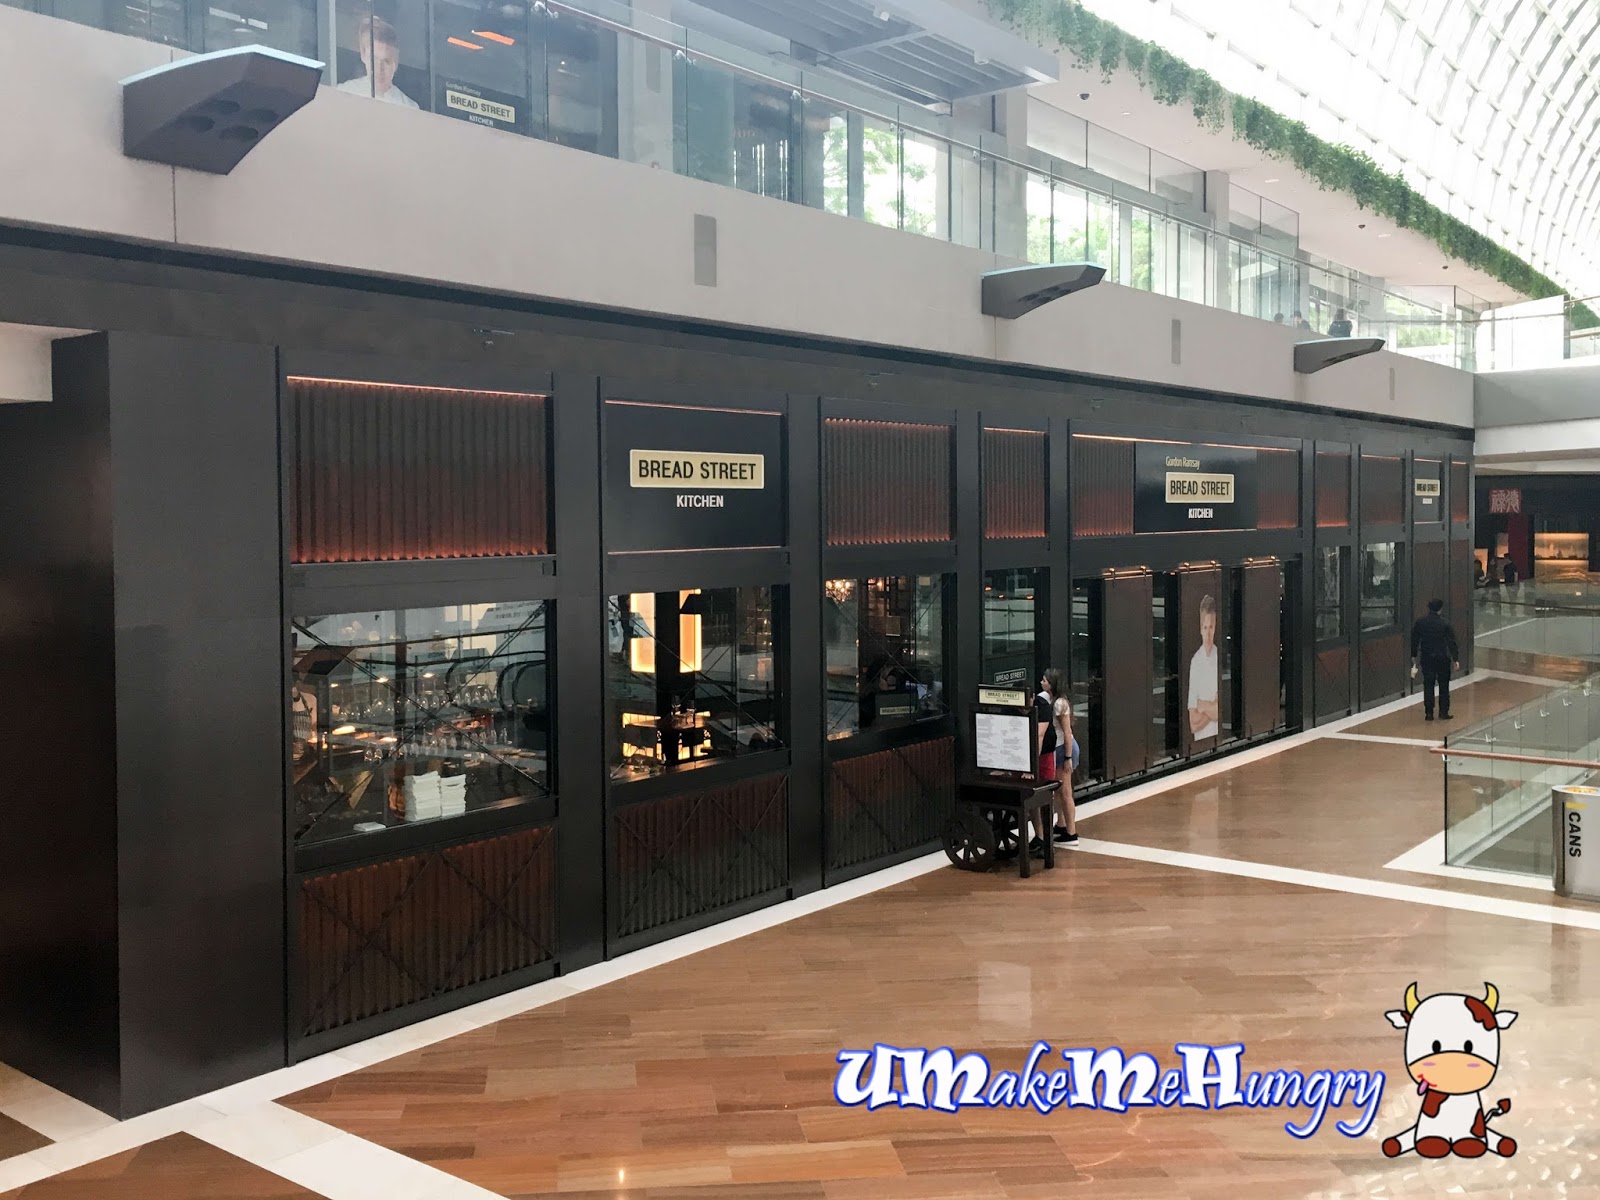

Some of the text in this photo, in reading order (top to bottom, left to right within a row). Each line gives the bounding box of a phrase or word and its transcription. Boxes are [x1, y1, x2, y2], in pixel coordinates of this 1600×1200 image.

[450, 95, 510, 118] BREAD STREET
[468, 115, 494, 126] KITCHEN
[639, 459, 756, 480] BREAD STREET
[1165, 456, 1200, 470] Gordon Ramsay
[1170, 480, 1230, 496] BREAD STREET
[676, 494, 724, 508] KITCHEN
[1188, 508, 1213, 519] KITCHEN
[995, 671, 1025, 682] BREAD STREET
[1568, 812, 1582, 858] CANS
